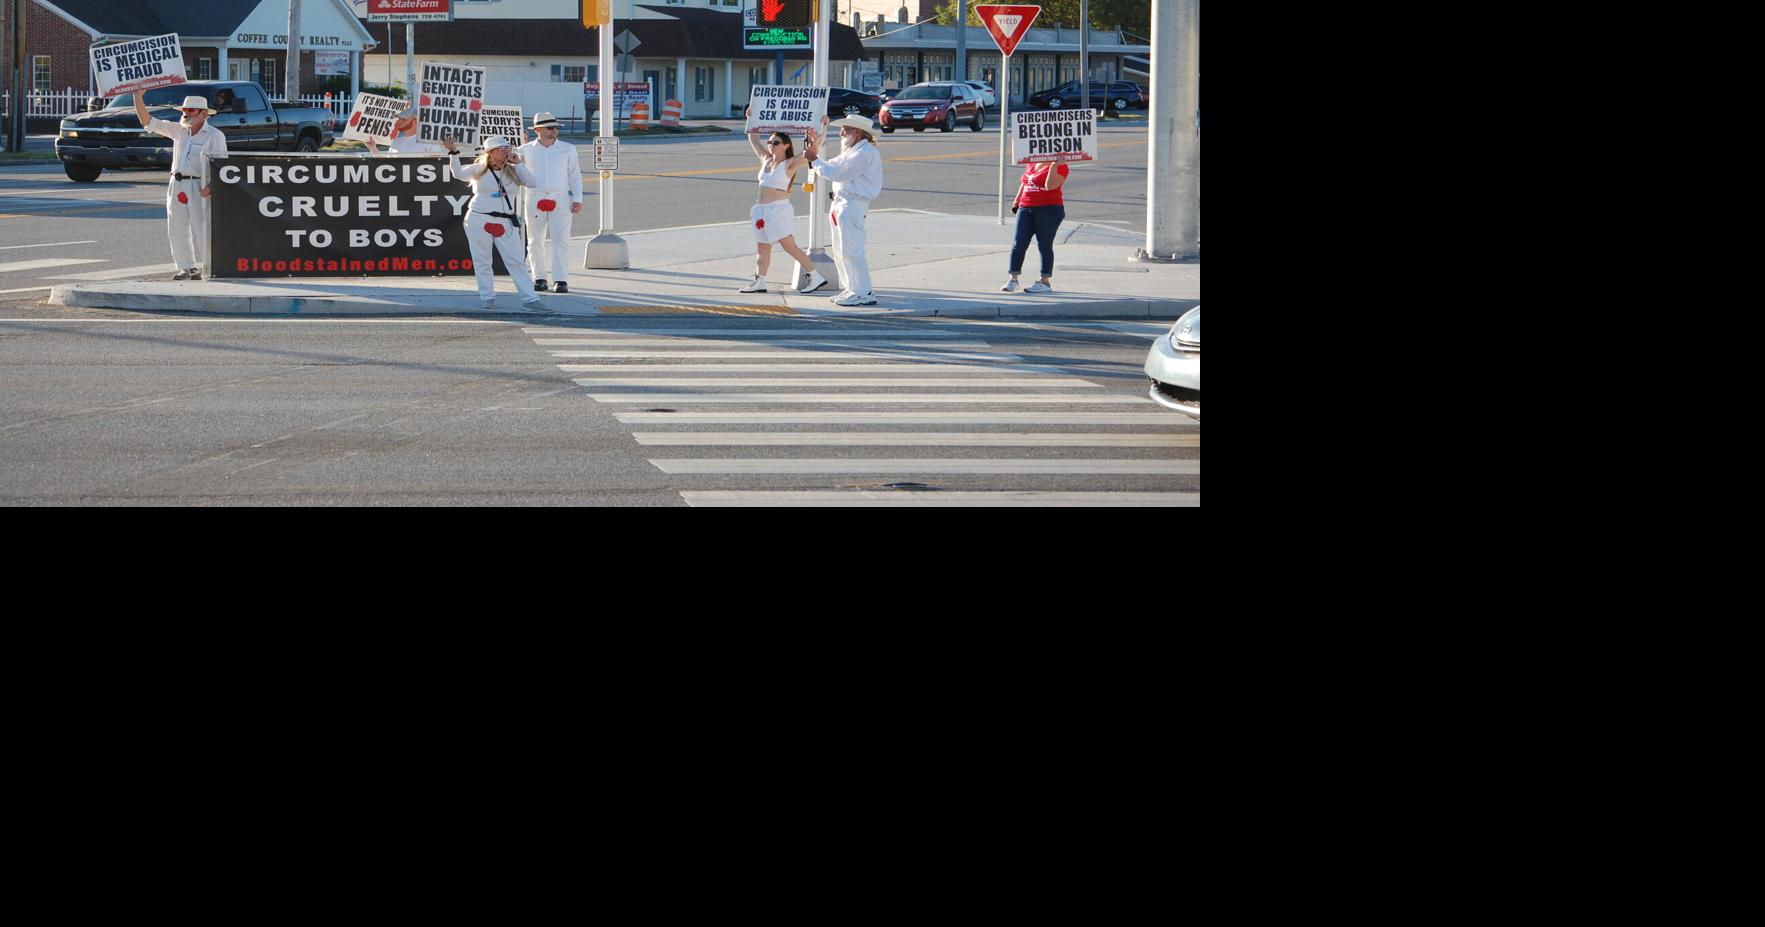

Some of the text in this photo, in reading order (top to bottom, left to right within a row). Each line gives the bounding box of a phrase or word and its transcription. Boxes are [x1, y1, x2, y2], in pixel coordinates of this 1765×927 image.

[93, 35, 176, 60] CIRCUMCISION
[237, 33, 268, 43] COFFEE
[273, 35, 305, 45] COUY
[310, 36, 340, 46] REALTY
[96, 46, 179, 72] IS MEDICAL
[117, 62, 163, 82] FRAUD
[423, 66, 483, 85] INTACT
[422, 81, 481, 98] GENITALS
[753, 87, 827, 99] CIRCUMCISION
[362, 95, 406, 112] IT'S NOT YOUR
[434, 97, 467, 109] ARE A
[766, 99, 810, 110] IS CHILD
[364, 106, 396, 119] MOTHER'S
[419, 108, 479, 127] HUMAN
[481, 109, 520, 117] CUMCISION
[481, 116, 521, 126] STORY'S
[759, 110, 813, 121] SEX ABUSE
[1017, 110, 1092, 124] CIRCUMCISERS
[356, 116, 393, 138] PENIS
[420, 125, 476, 144] RIGHT
[480, 126, 521, 136] REATEST
[1019, 121, 1092, 139] BELONG IN
[1029, 137, 1082, 154] PRISON
[219, 164, 450, 184] CIRCUMCISI
[259, 195, 471, 217] CRUELTY
[285, 228, 444, 248] TO BOYS
[237, 257, 473, 272] BloodstainedMen.co
